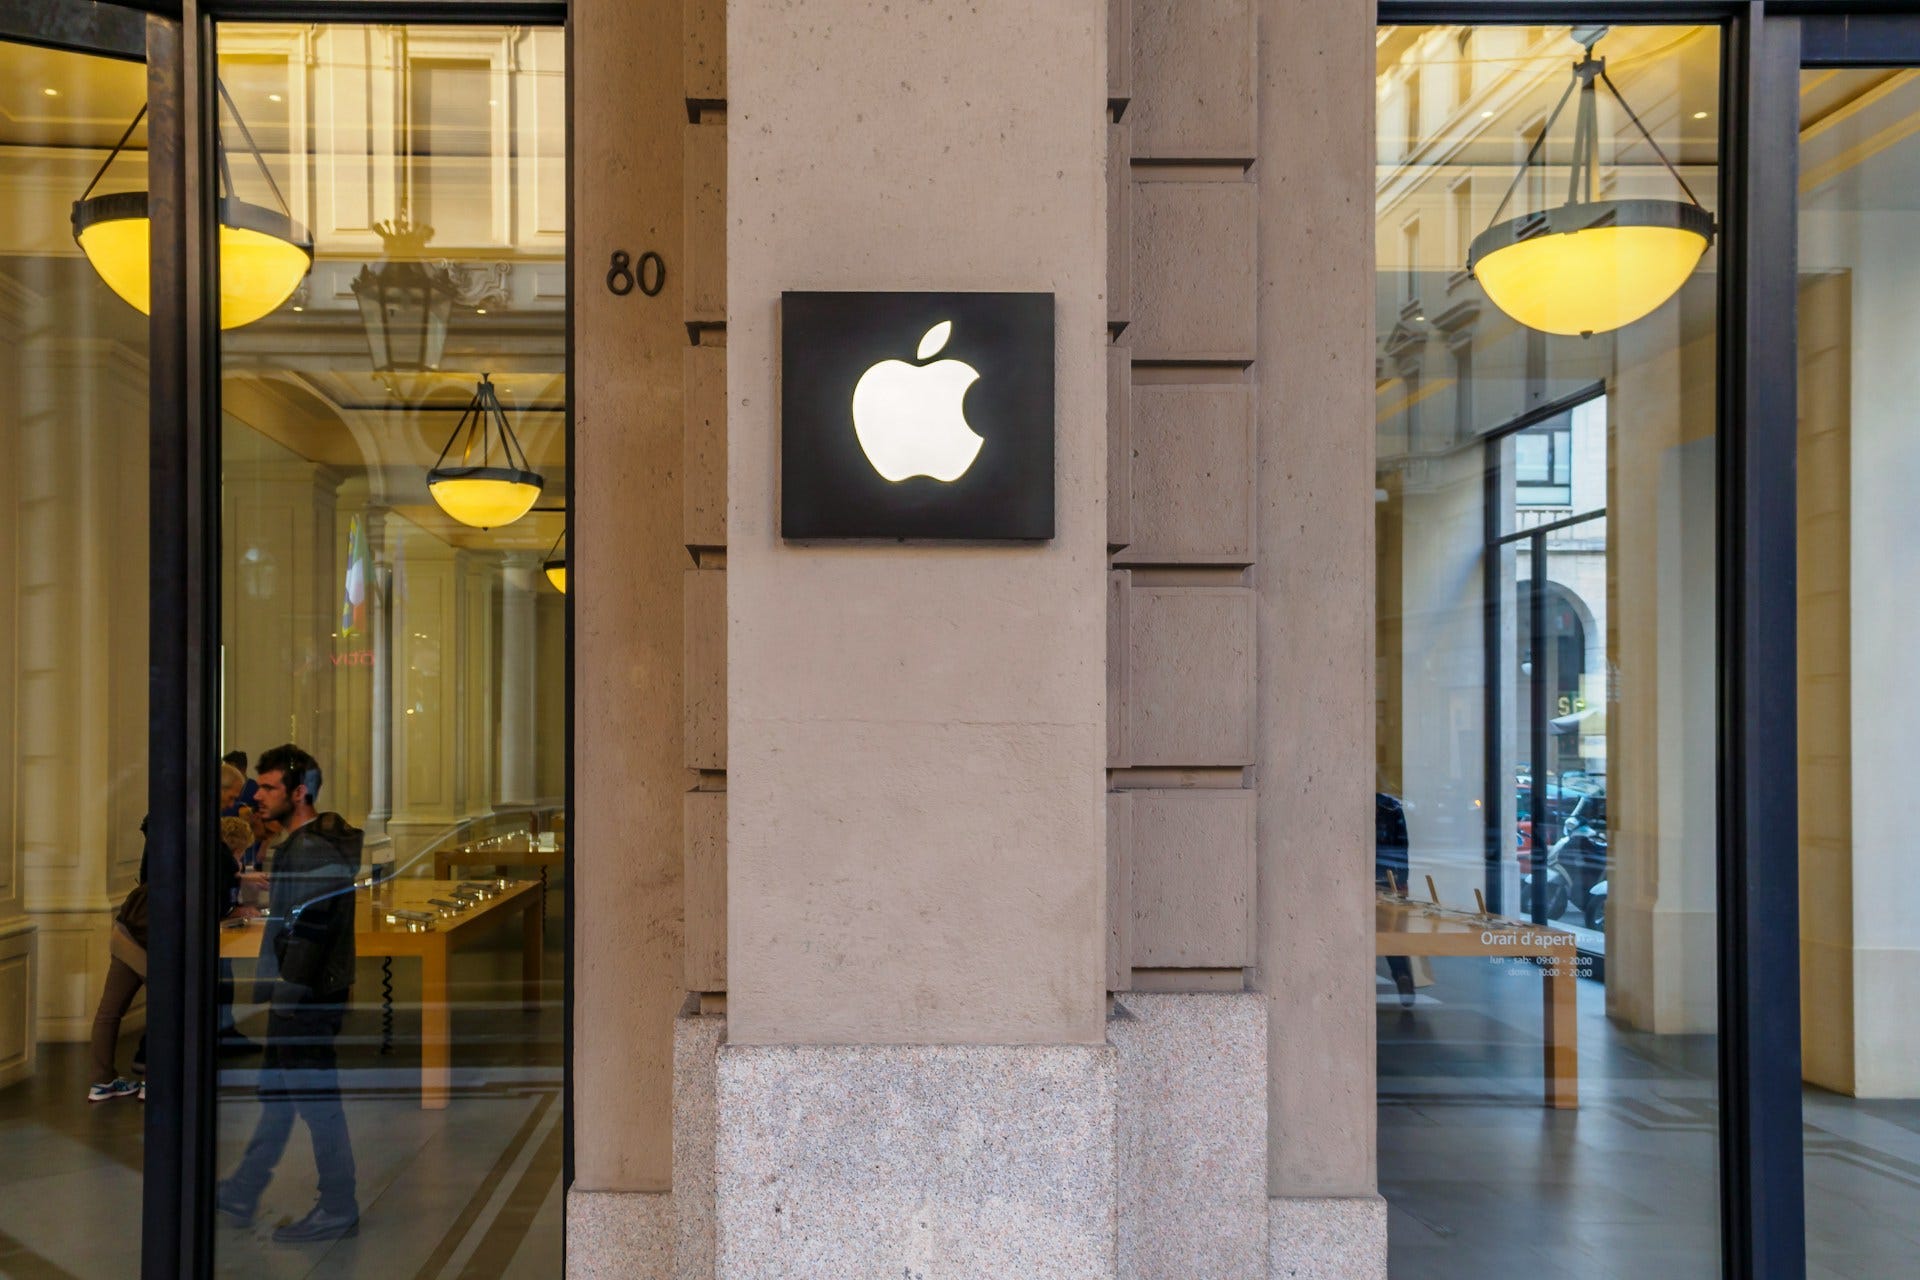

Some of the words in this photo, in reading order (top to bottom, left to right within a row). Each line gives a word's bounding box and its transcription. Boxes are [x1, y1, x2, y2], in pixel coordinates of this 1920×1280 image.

[606, 249, 666, 297] 80
[1481, 931, 1516, 945] Orari
[1521, 931, 1598, 948] d'apertu
[1489, 956, 1504, 964] lun
[1536, 956, 1560, 965] 09:00
[1569, 956, 1593, 965] 20:00
[1569, 968, 1593, 977] 20:00
